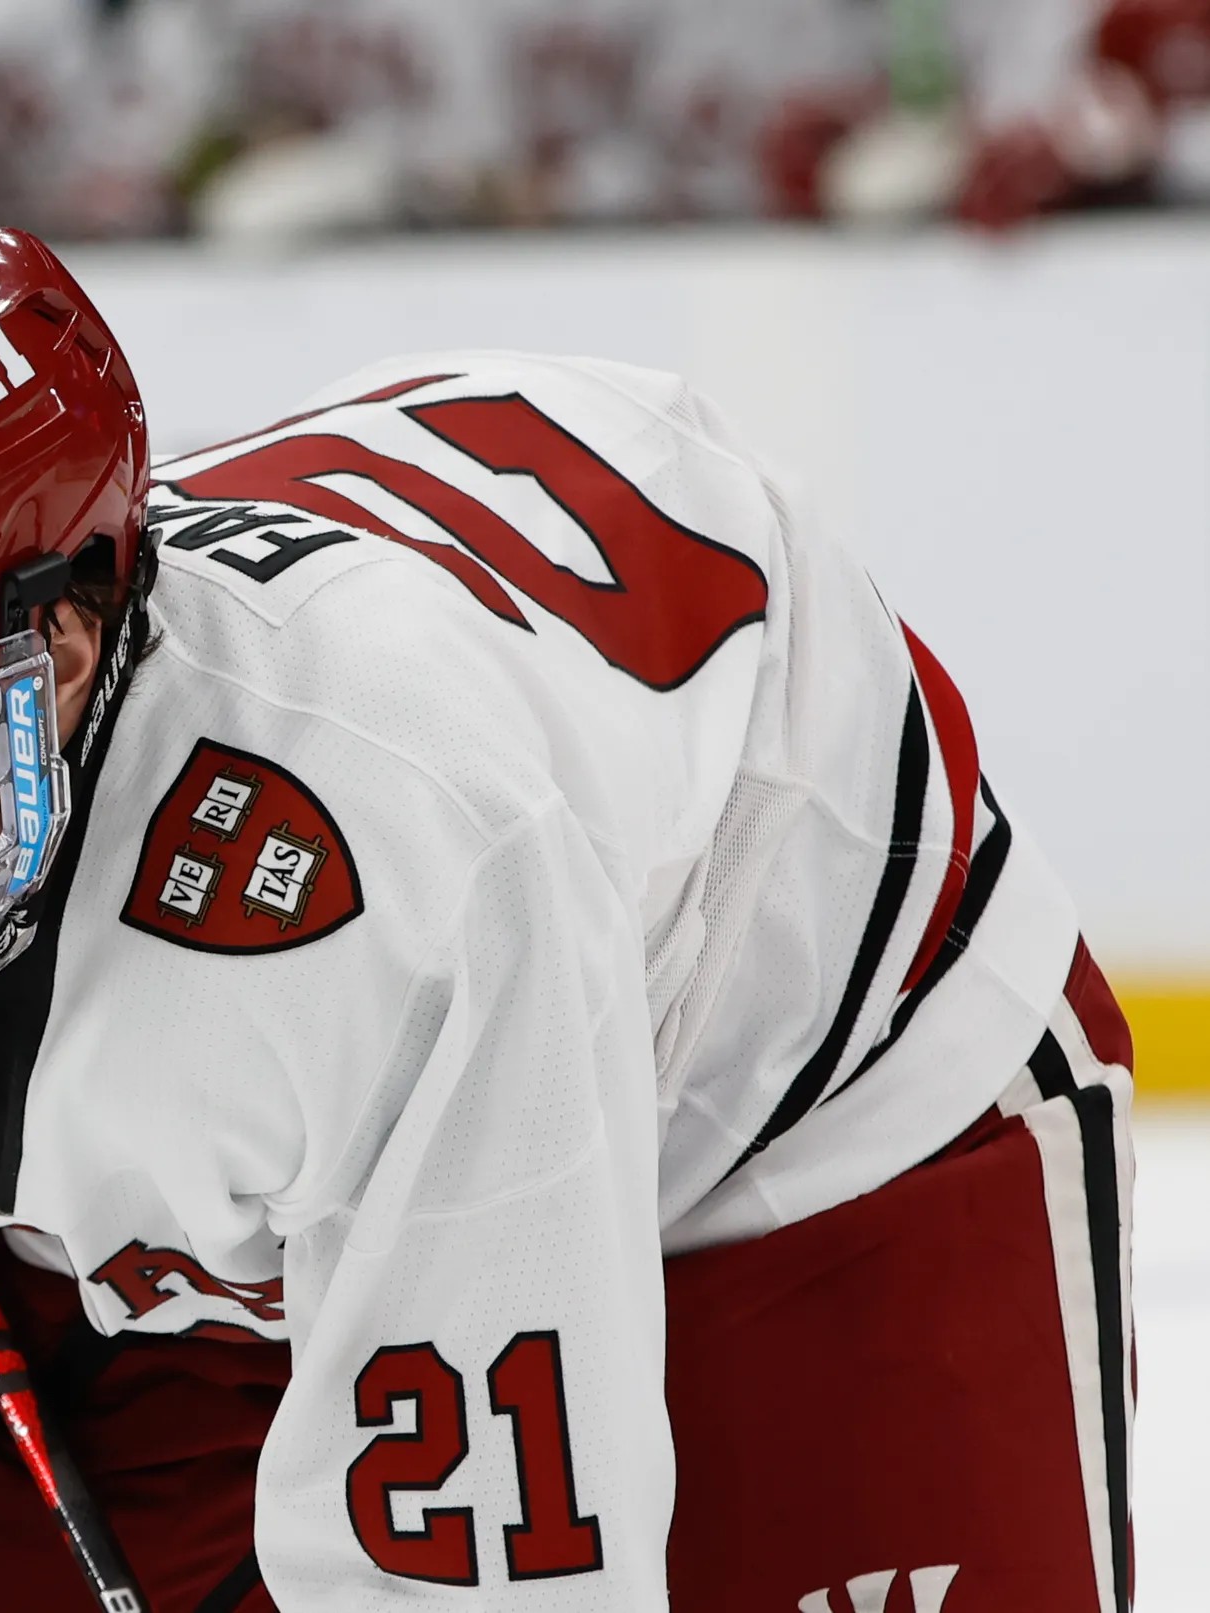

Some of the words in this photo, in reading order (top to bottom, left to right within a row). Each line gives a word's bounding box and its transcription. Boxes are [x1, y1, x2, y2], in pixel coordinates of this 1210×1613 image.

[167, 861, 204, 904] VE
[203, 786, 240, 826] RI
[257, 844, 302, 902] TAS
[346, 1329, 604, 1587] 21
